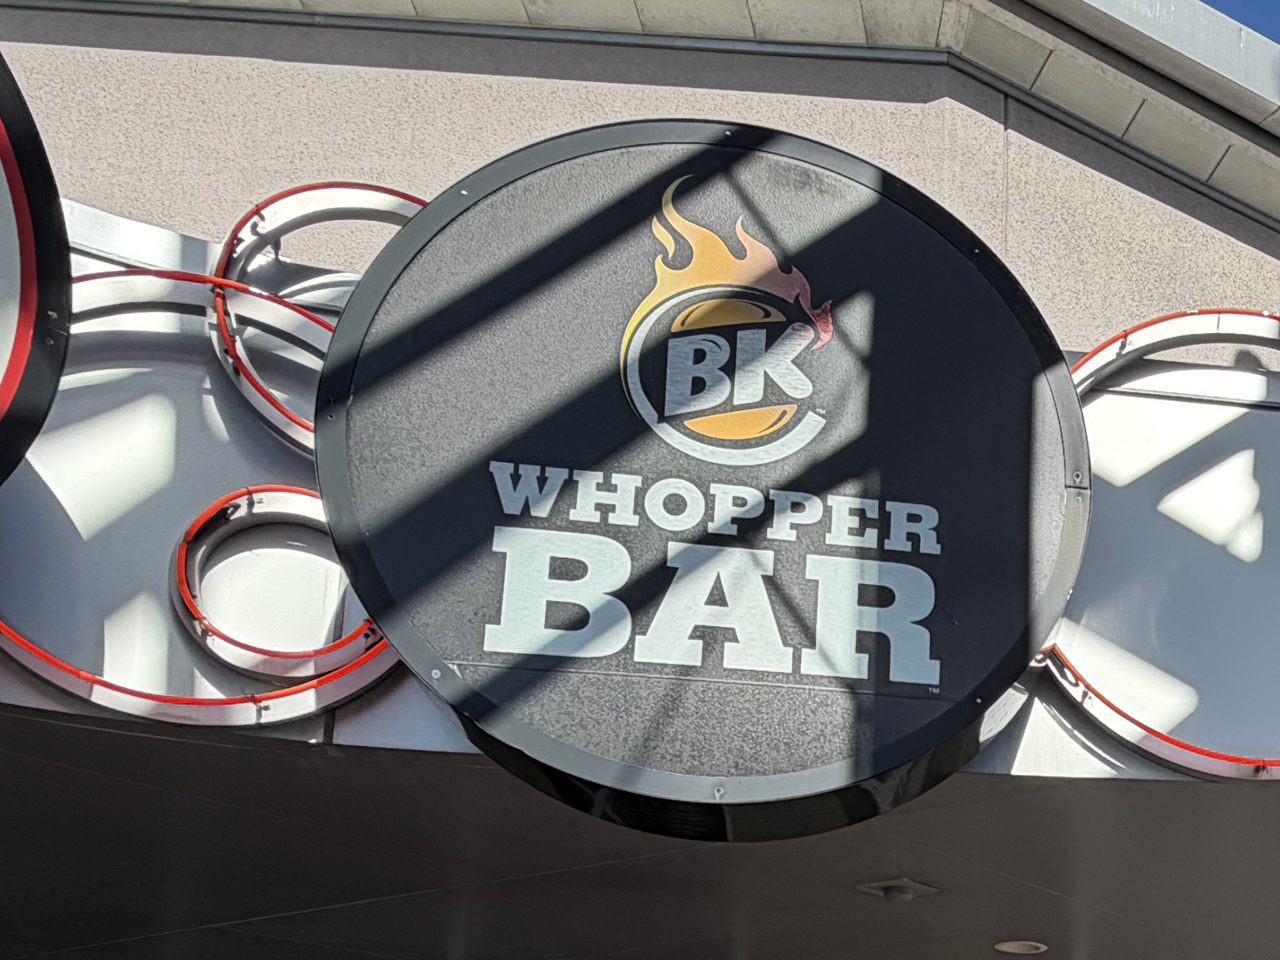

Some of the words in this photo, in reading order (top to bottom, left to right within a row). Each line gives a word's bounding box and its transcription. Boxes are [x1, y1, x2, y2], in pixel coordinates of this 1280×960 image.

[664, 322, 816, 417] BK
[489, 460, 942, 555] WHOPPER
[483, 525, 941, 686] BAR
